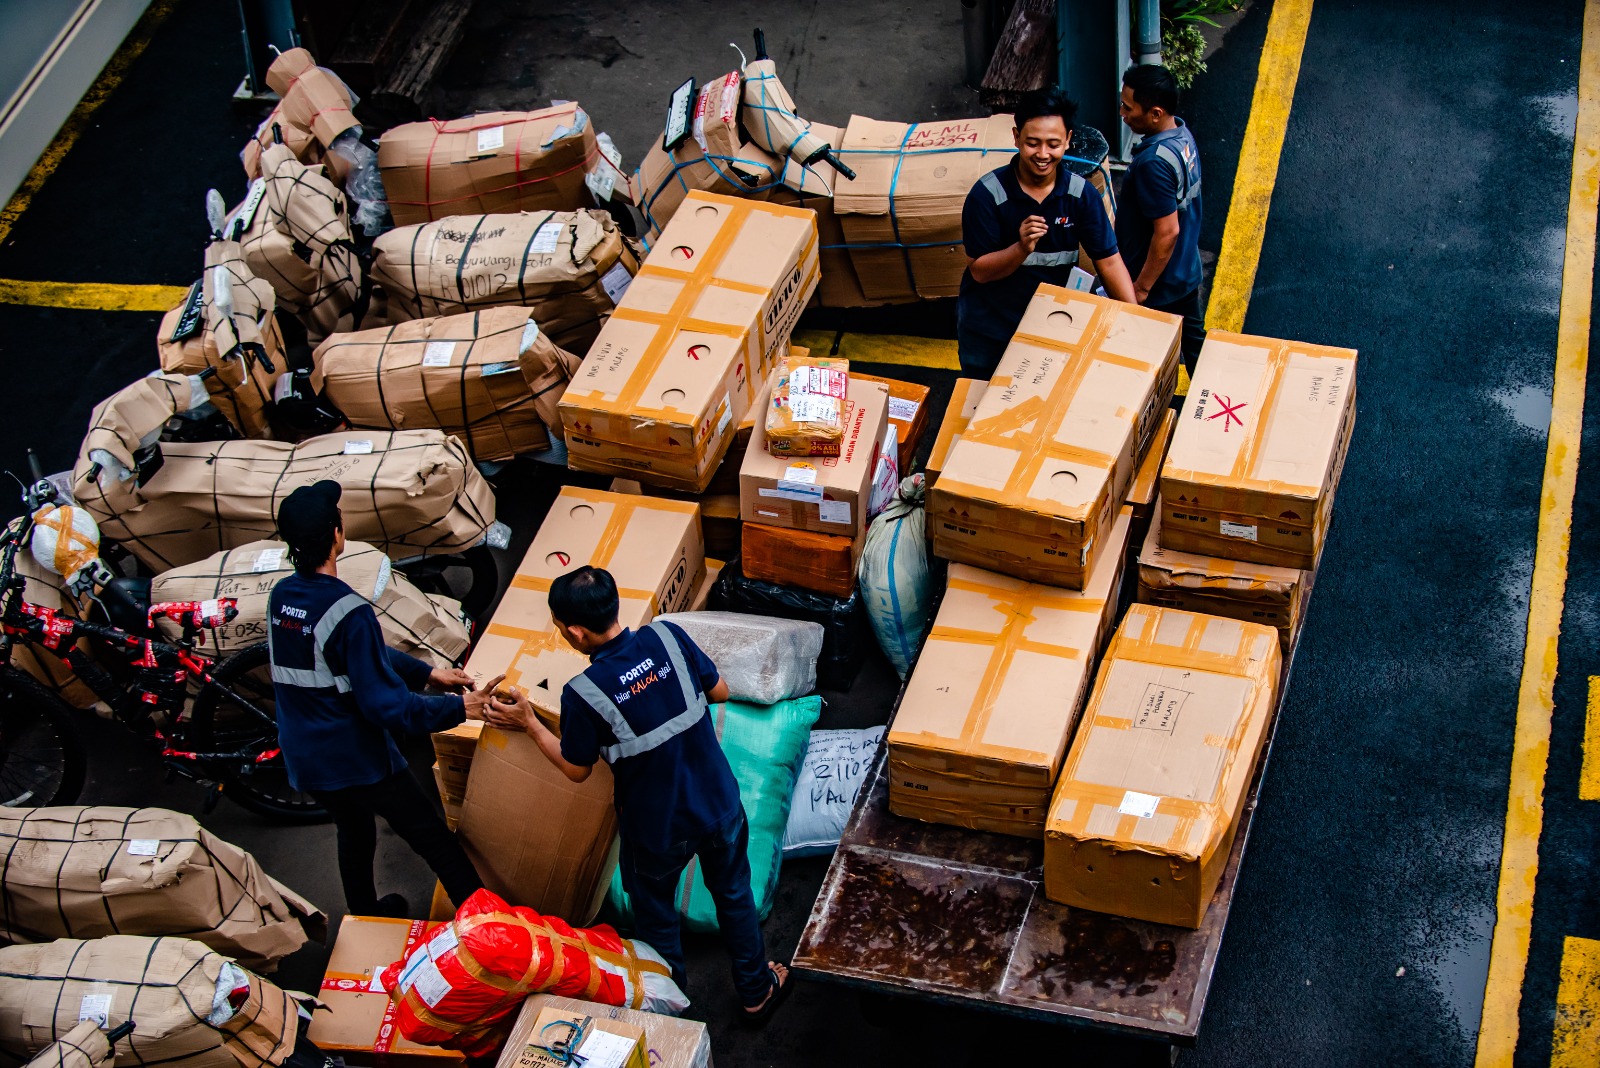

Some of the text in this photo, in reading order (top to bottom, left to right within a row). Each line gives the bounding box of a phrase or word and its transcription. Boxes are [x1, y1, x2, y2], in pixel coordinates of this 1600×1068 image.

[912, 123, 975, 140] N-ML
[844, 408, 866, 464] JANGAN DIBANTING
[280, 604, 307, 620] PORTER
[619, 658, 655, 685] PORTER
